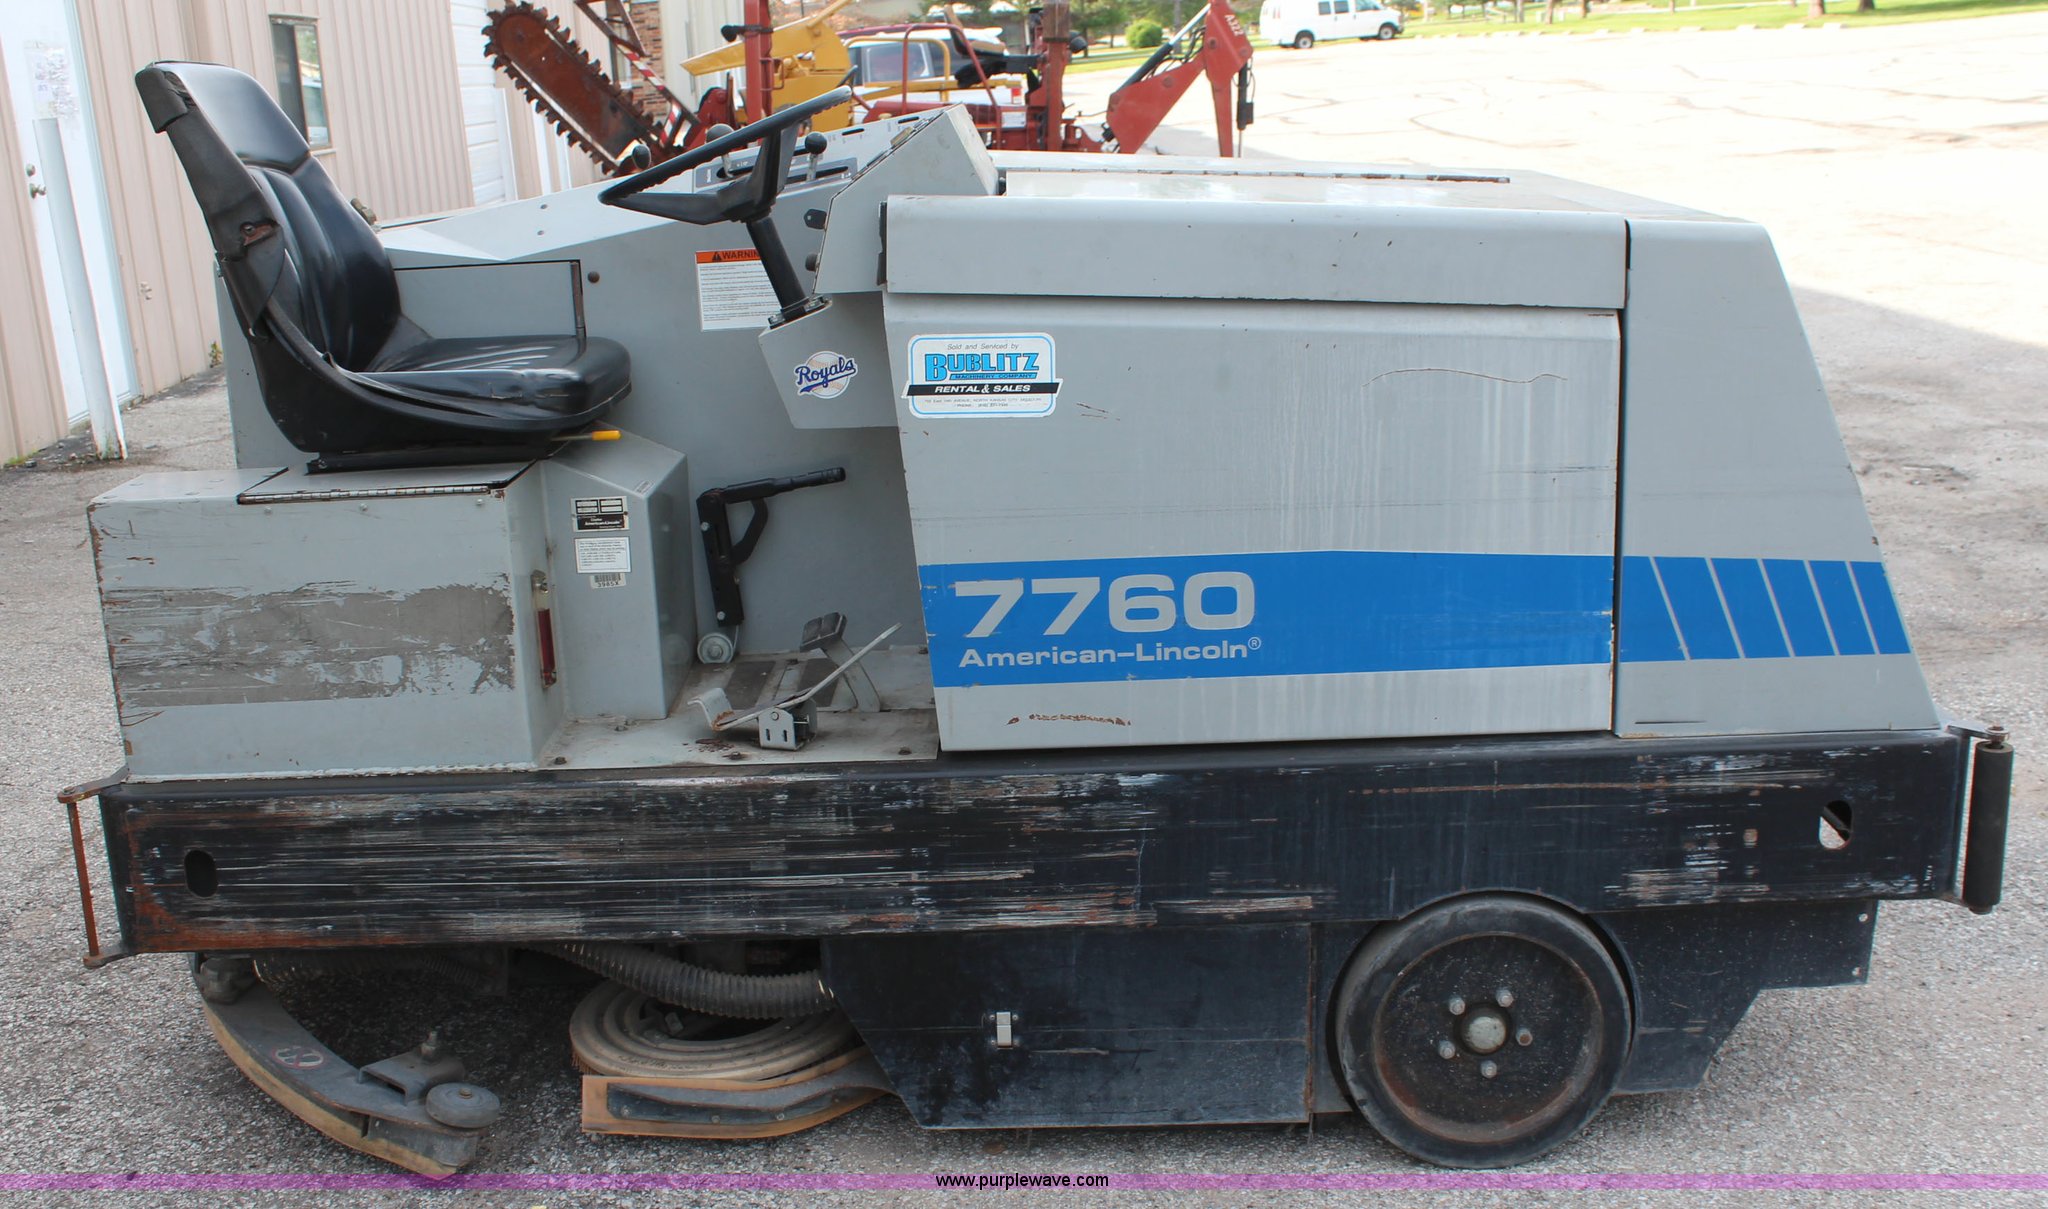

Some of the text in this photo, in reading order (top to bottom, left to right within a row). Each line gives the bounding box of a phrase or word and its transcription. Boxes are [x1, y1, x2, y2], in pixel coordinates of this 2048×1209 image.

[722, 249, 760, 259] WARNIN
[795, 356, 856, 390] Royals
[925, 352, 1040, 382] BUBLITZ
[934, 384, 1031, 394] RENTAL & SALES
[955, 571, 1255, 638] 7760
